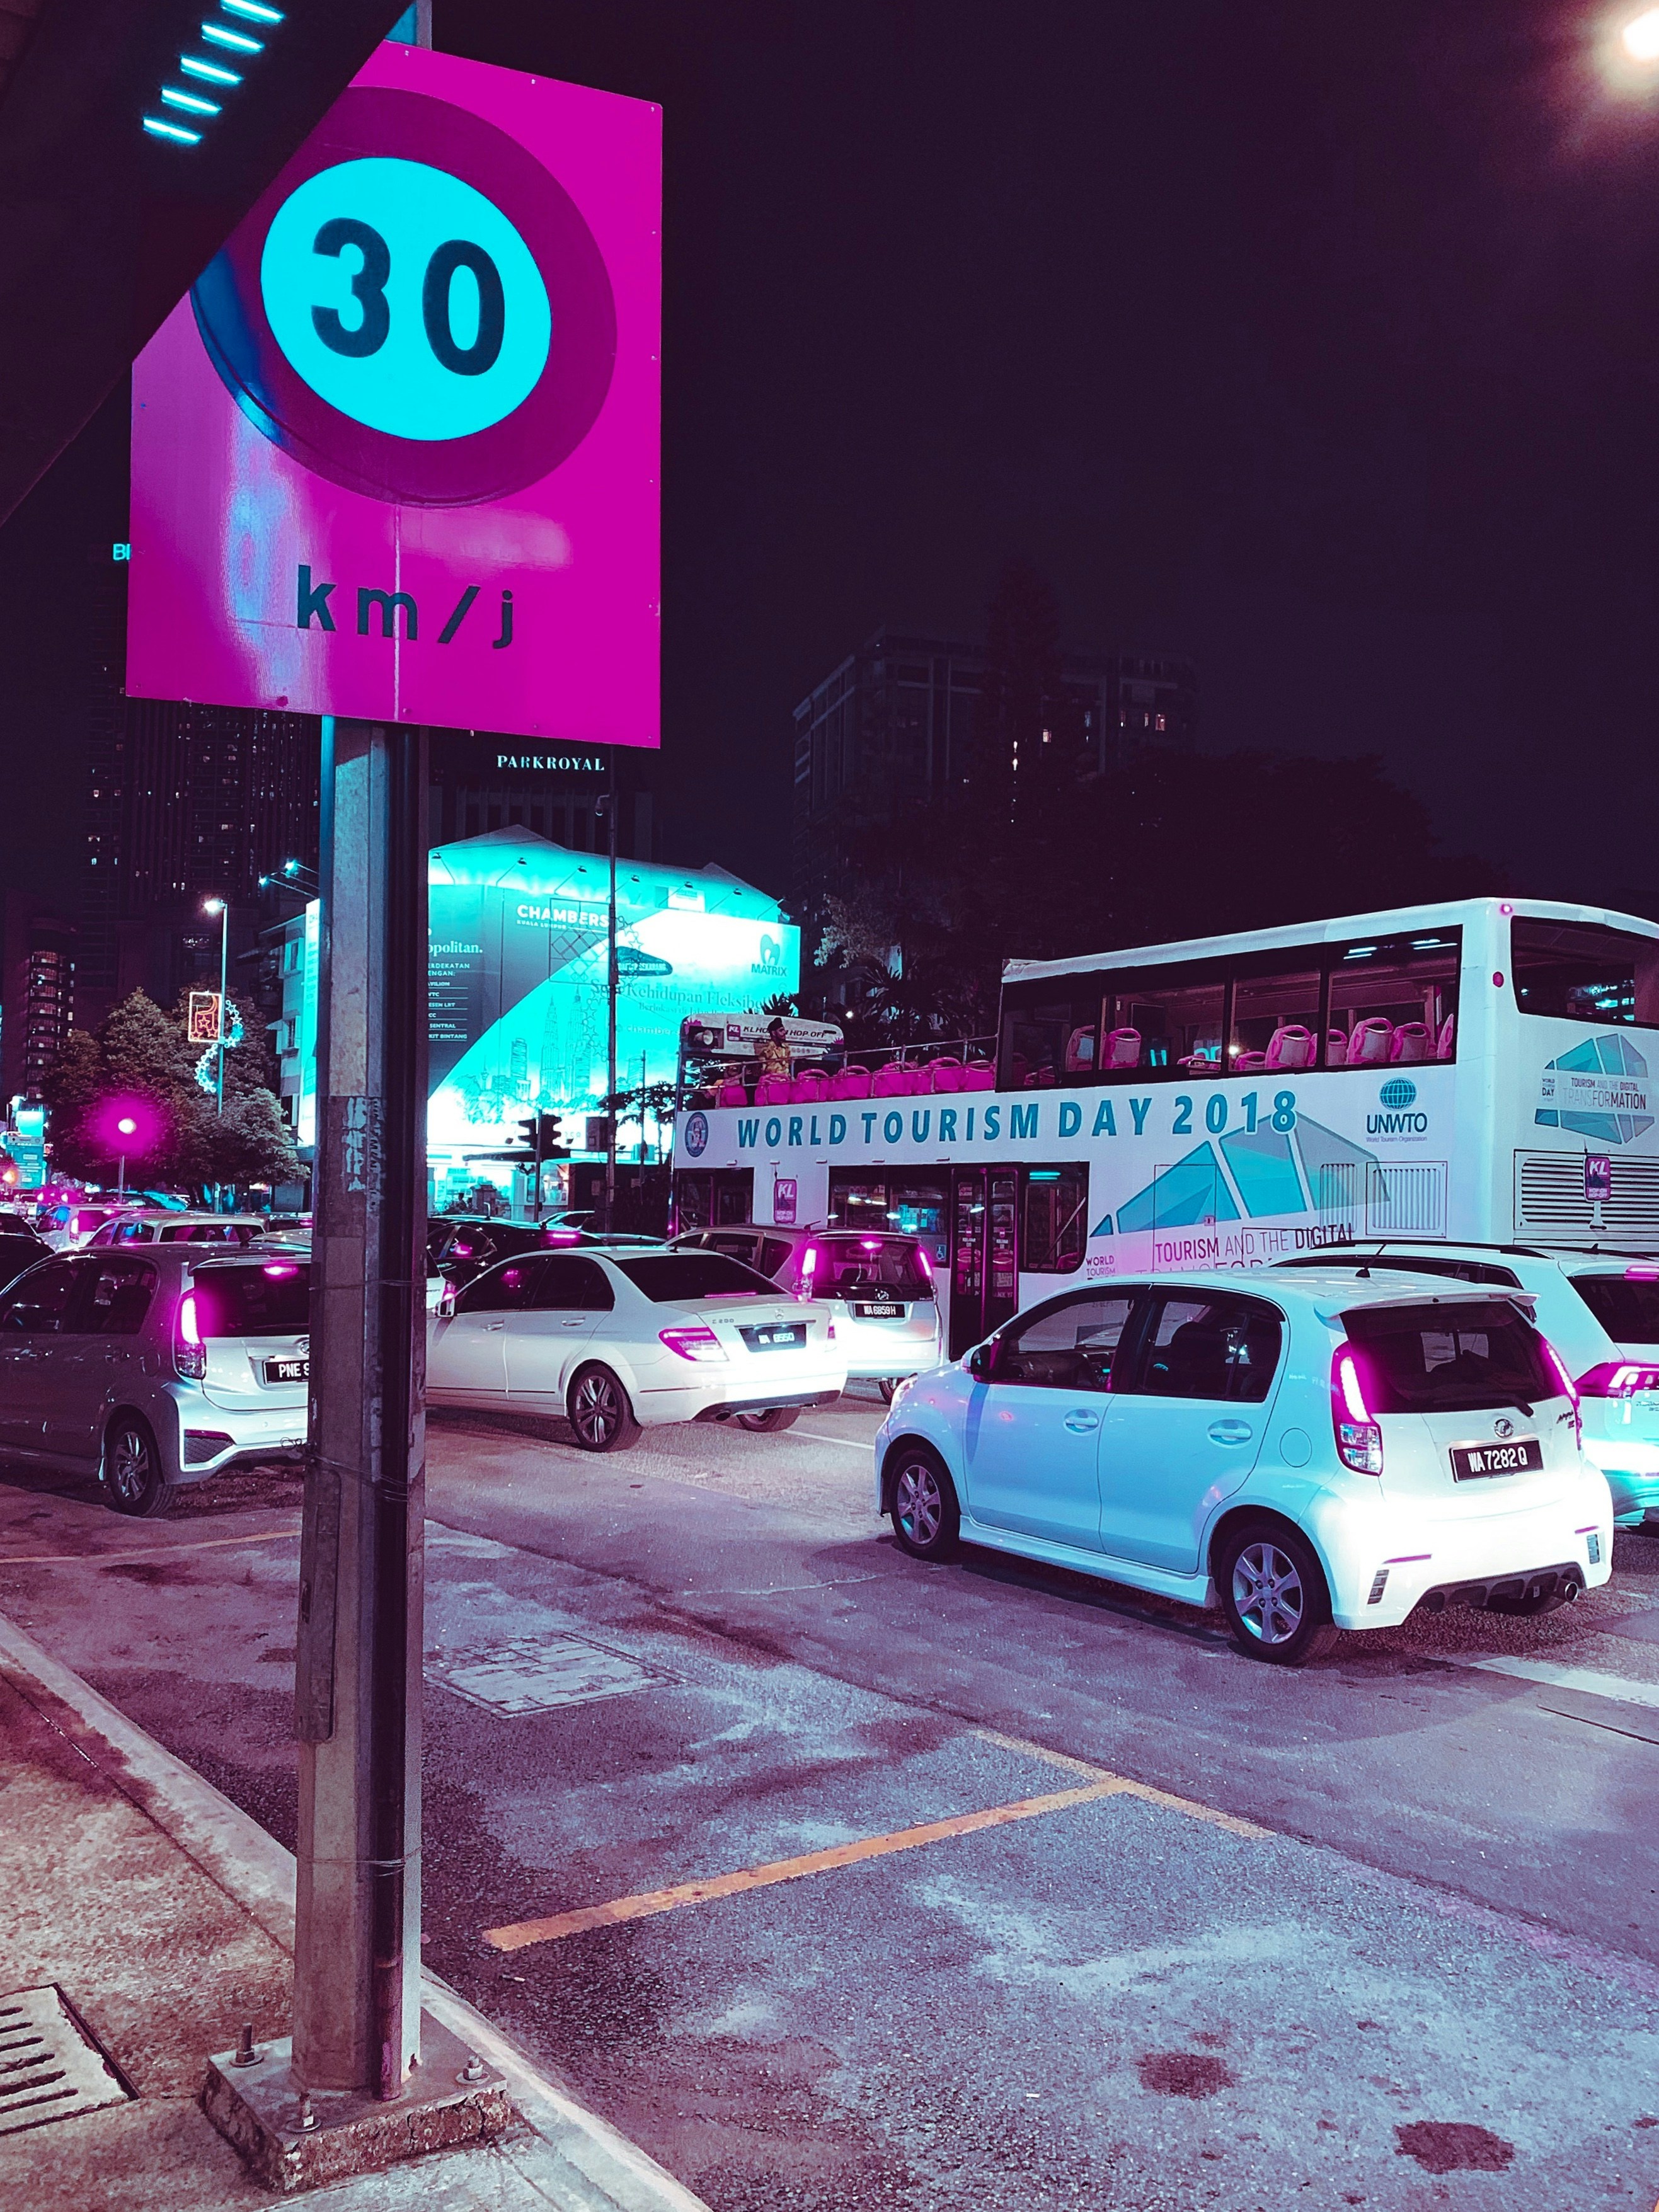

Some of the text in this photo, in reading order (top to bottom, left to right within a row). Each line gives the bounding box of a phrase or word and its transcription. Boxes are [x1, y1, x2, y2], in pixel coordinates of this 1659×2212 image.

[311, 217, 505, 377] 30
[297, 564, 514, 649] km/j
[497, 755, 605, 771] PARKROYAL
[516, 904, 609, 927] CHAMBERS
[750, 963, 788, 977] MATRIX
[1542, 1087, 1554, 1096] DAY
[1571, 1077, 1595, 1088] TOURISM
[1620, 1082, 1639, 1092] DIGITAL
[1563, 1087, 1646, 1110] TRANSFORMATION
[738, 1114, 847, 1148] WORLD
[861, 1103, 1040, 1144] TOURISM
[1058, 1098, 1152, 1137] DAY
[1172, 1090, 1296, 1135] 2018
[1367, 1113, 1428, 1134] UNWTO
[1589, 1160, 1607, 1175] KL
[778, 1184, 794, 1198] KL
[1155, 1237, 1219, 1263] TOURISM
[1226, 1234, 1254, 1256] AND
[1260, 1230, 1289, 1252] THE
[1086, 1255, 1115, 1266] WORLD
[1086, 1266, 1116, 1276] TOURISM
[278, 1363, 302, 1378] PNE
